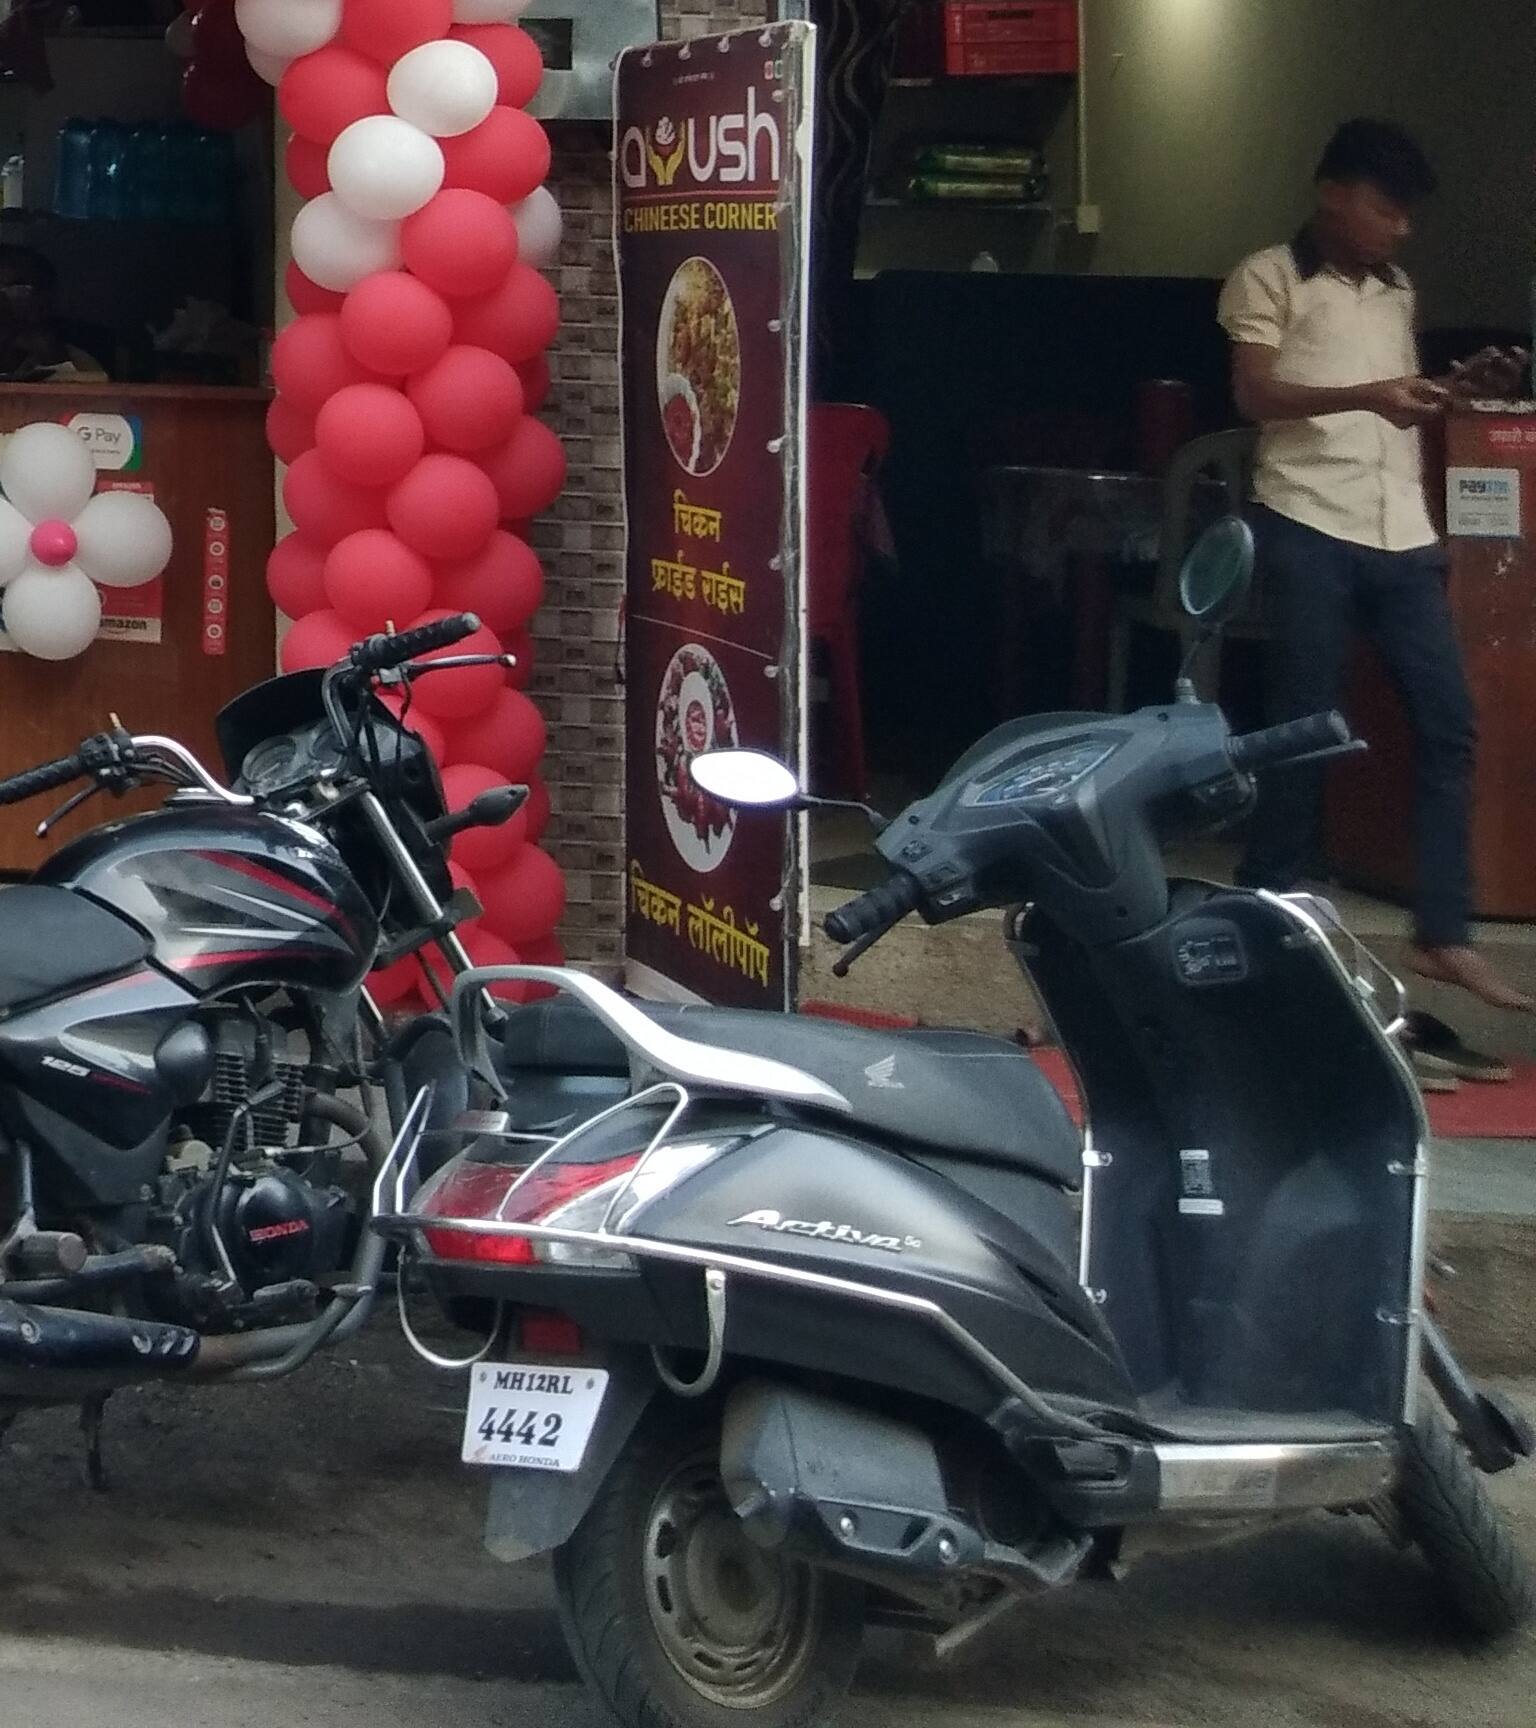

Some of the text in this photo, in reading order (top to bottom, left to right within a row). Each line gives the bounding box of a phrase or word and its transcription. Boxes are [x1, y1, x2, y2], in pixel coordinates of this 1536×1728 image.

[624, 201, 778, 233] CHINEESE CORNER
[95, 427, 121, 444] Pay
[672, 488, 722, 543] चिकन
[630, 858, 770, 988] चिकन लॉलीपॉप
[725, 1209, 903, 1253] Activa
[493, 1370, 575, 1395] MH12RL
[477, 1406, 563, 1448] 4442
[517, 1454, 561, 1468] HONDA
